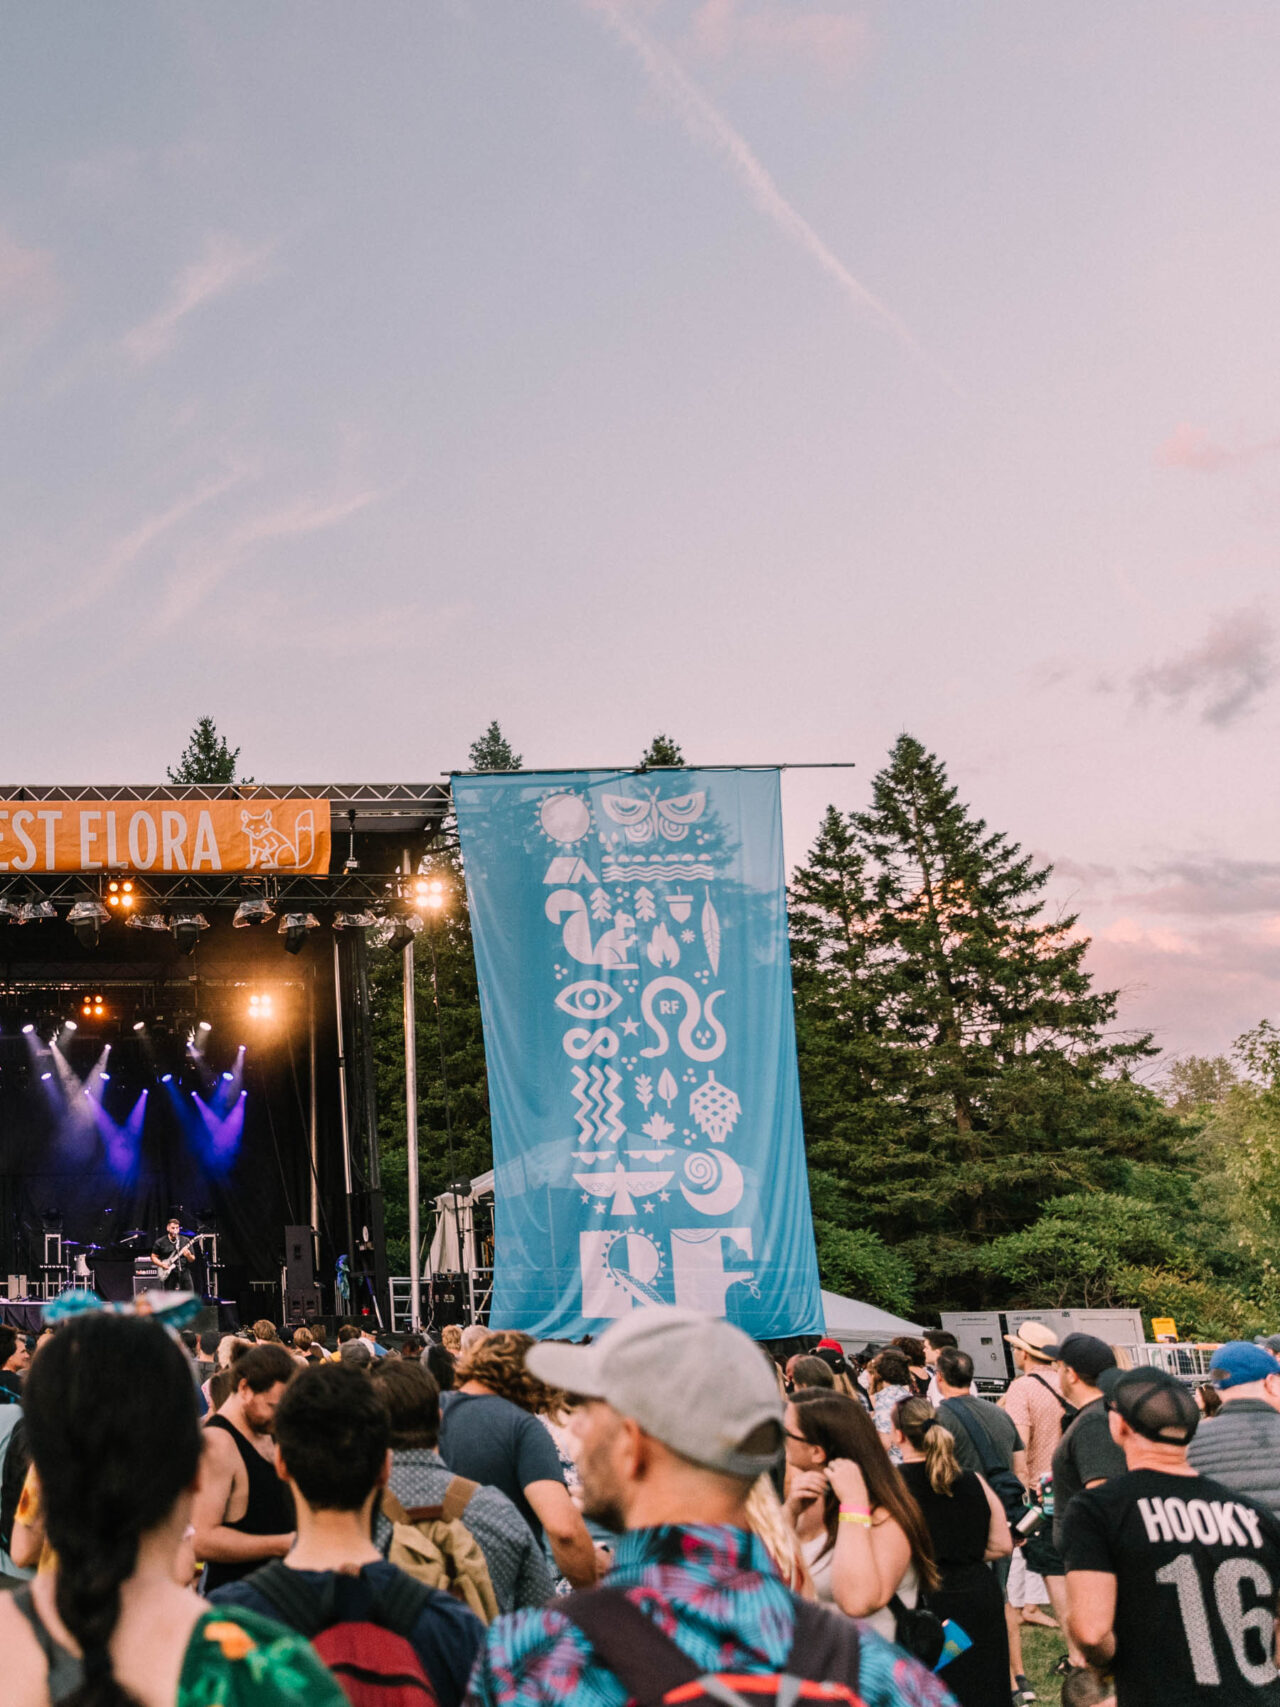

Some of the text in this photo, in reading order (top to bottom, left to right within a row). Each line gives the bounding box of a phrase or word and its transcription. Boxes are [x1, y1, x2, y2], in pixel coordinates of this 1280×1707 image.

[79, 809, 222, 871] ELORA
[660, 1000, 679, 1015] RF
[1137, 1497, 1263, 1548] HOOKY
[1155, 1554, 1277, 1687] 16
